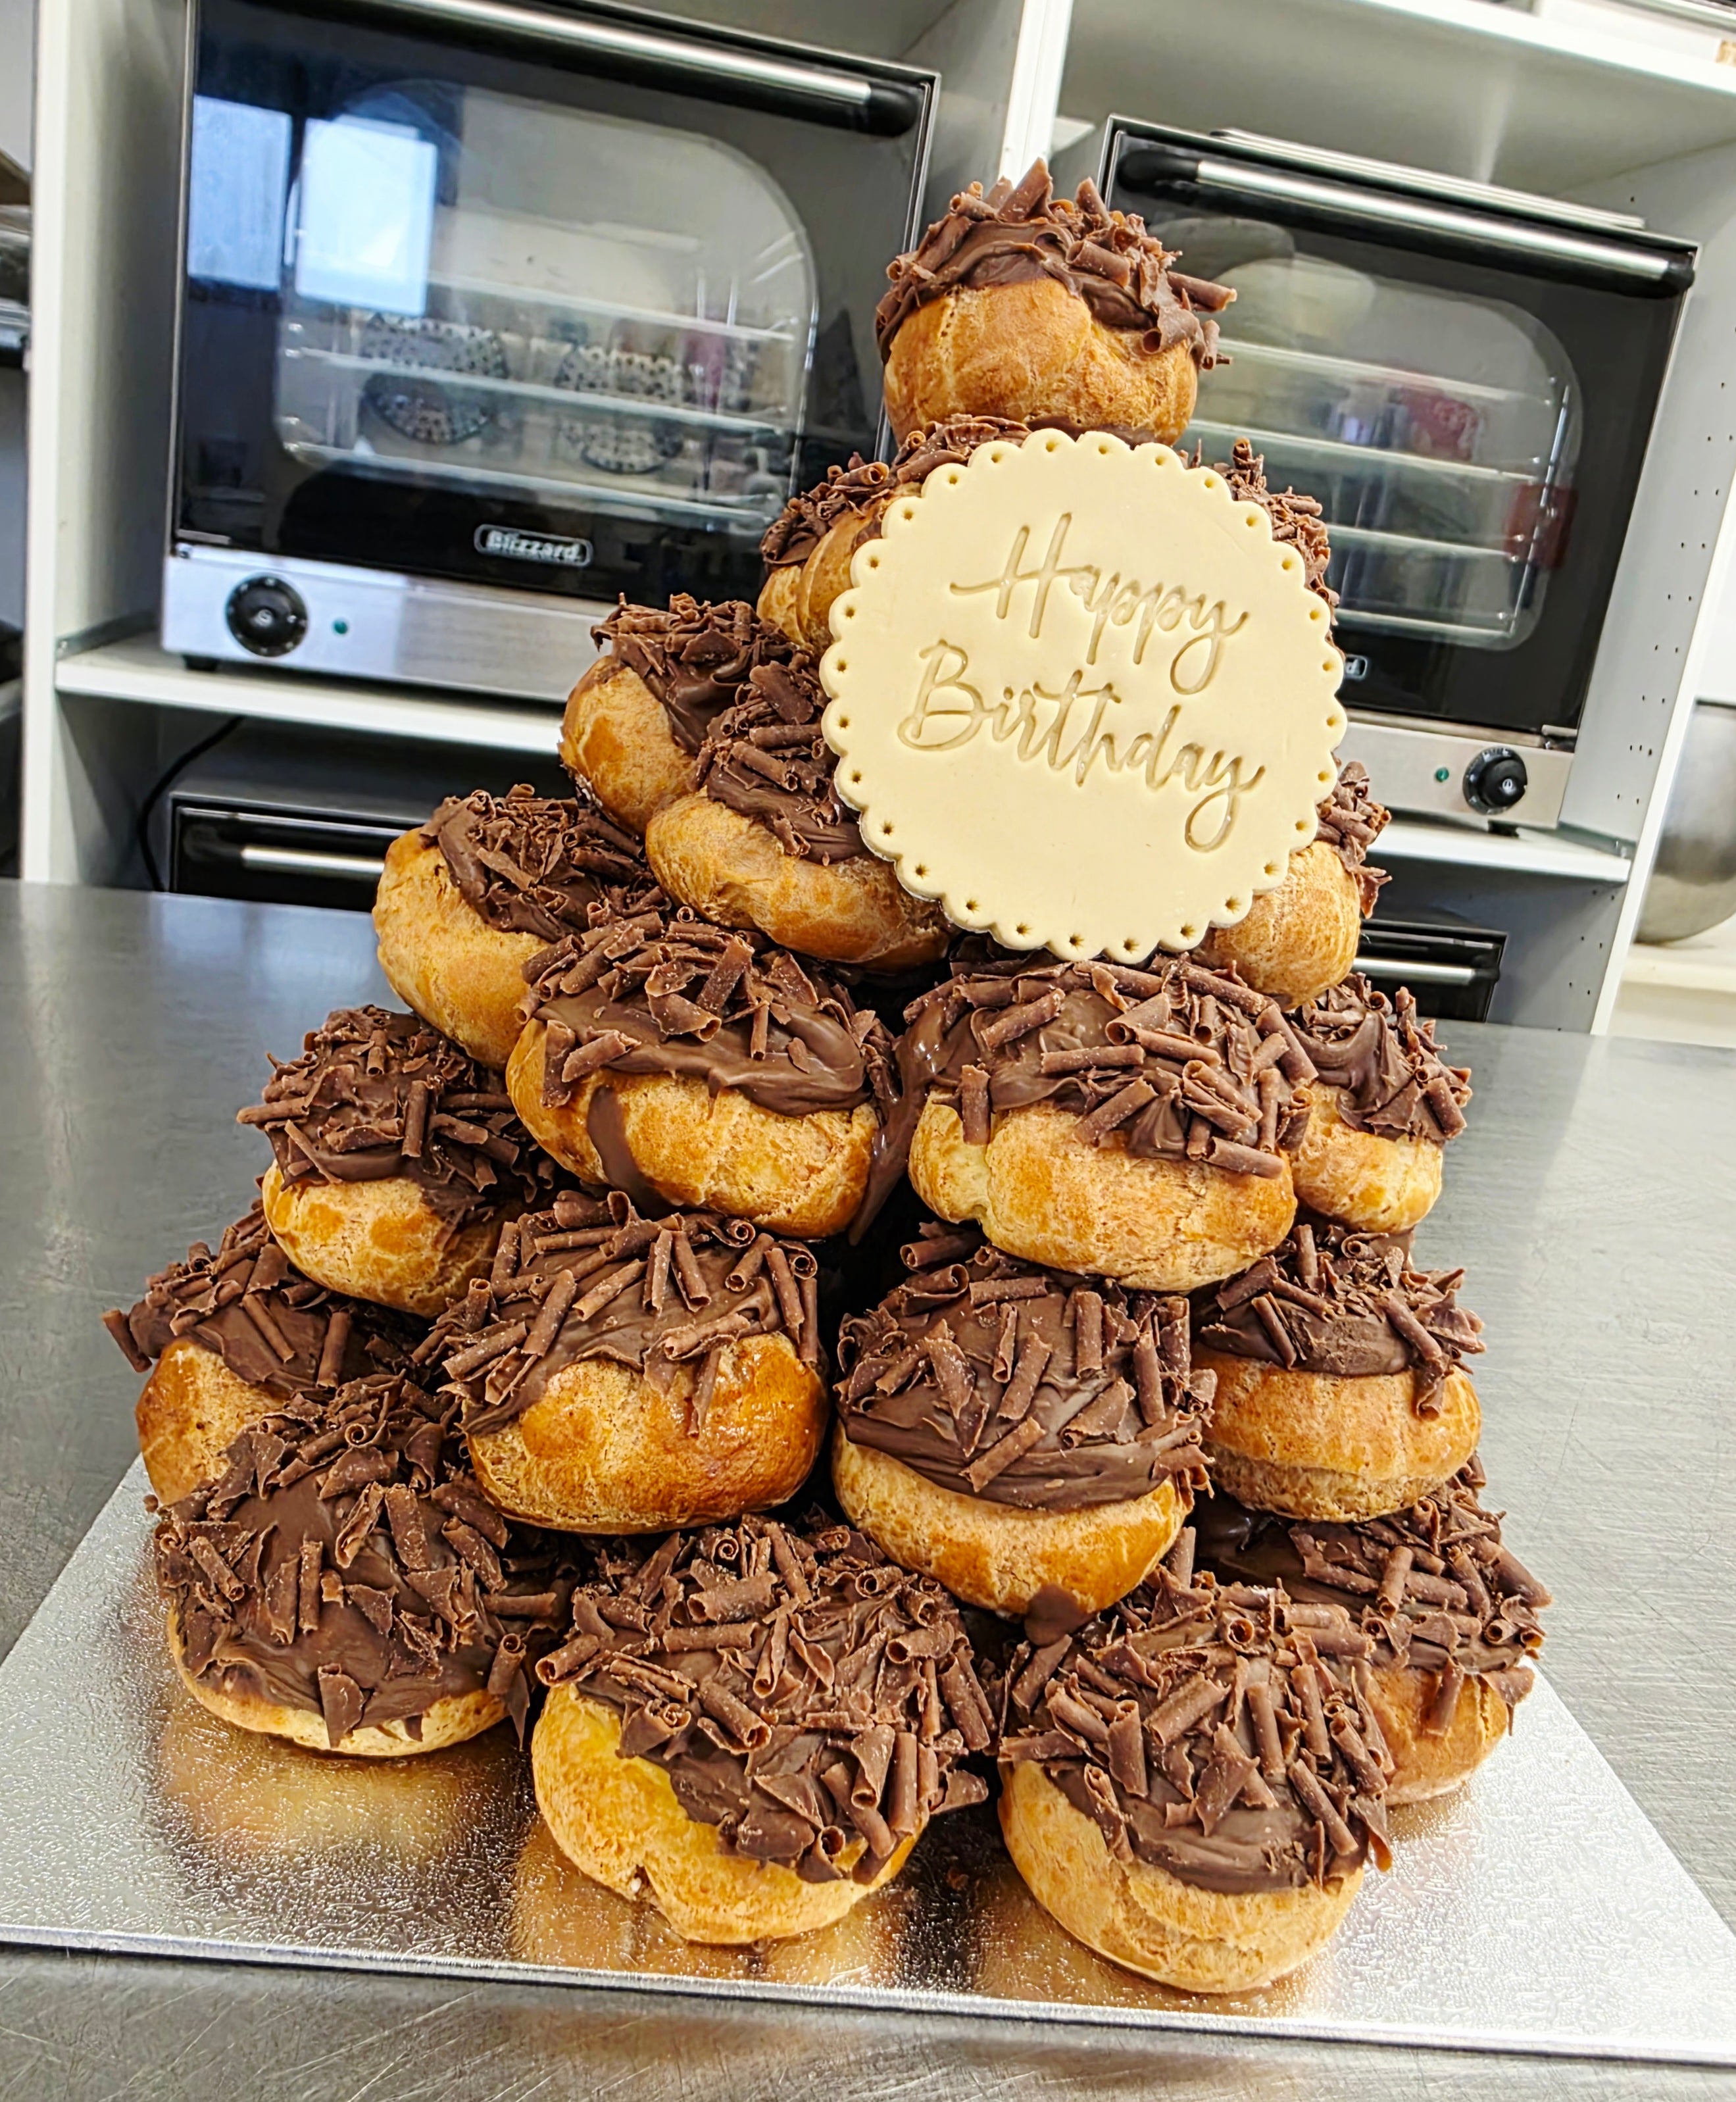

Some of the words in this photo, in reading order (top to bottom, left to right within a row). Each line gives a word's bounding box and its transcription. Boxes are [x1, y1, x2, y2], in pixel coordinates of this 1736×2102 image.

[486, 530, 581, 561] Blizzard
[949, 513, 1249, 695] Happy
[897, 639, 1266, 852] Birthday
